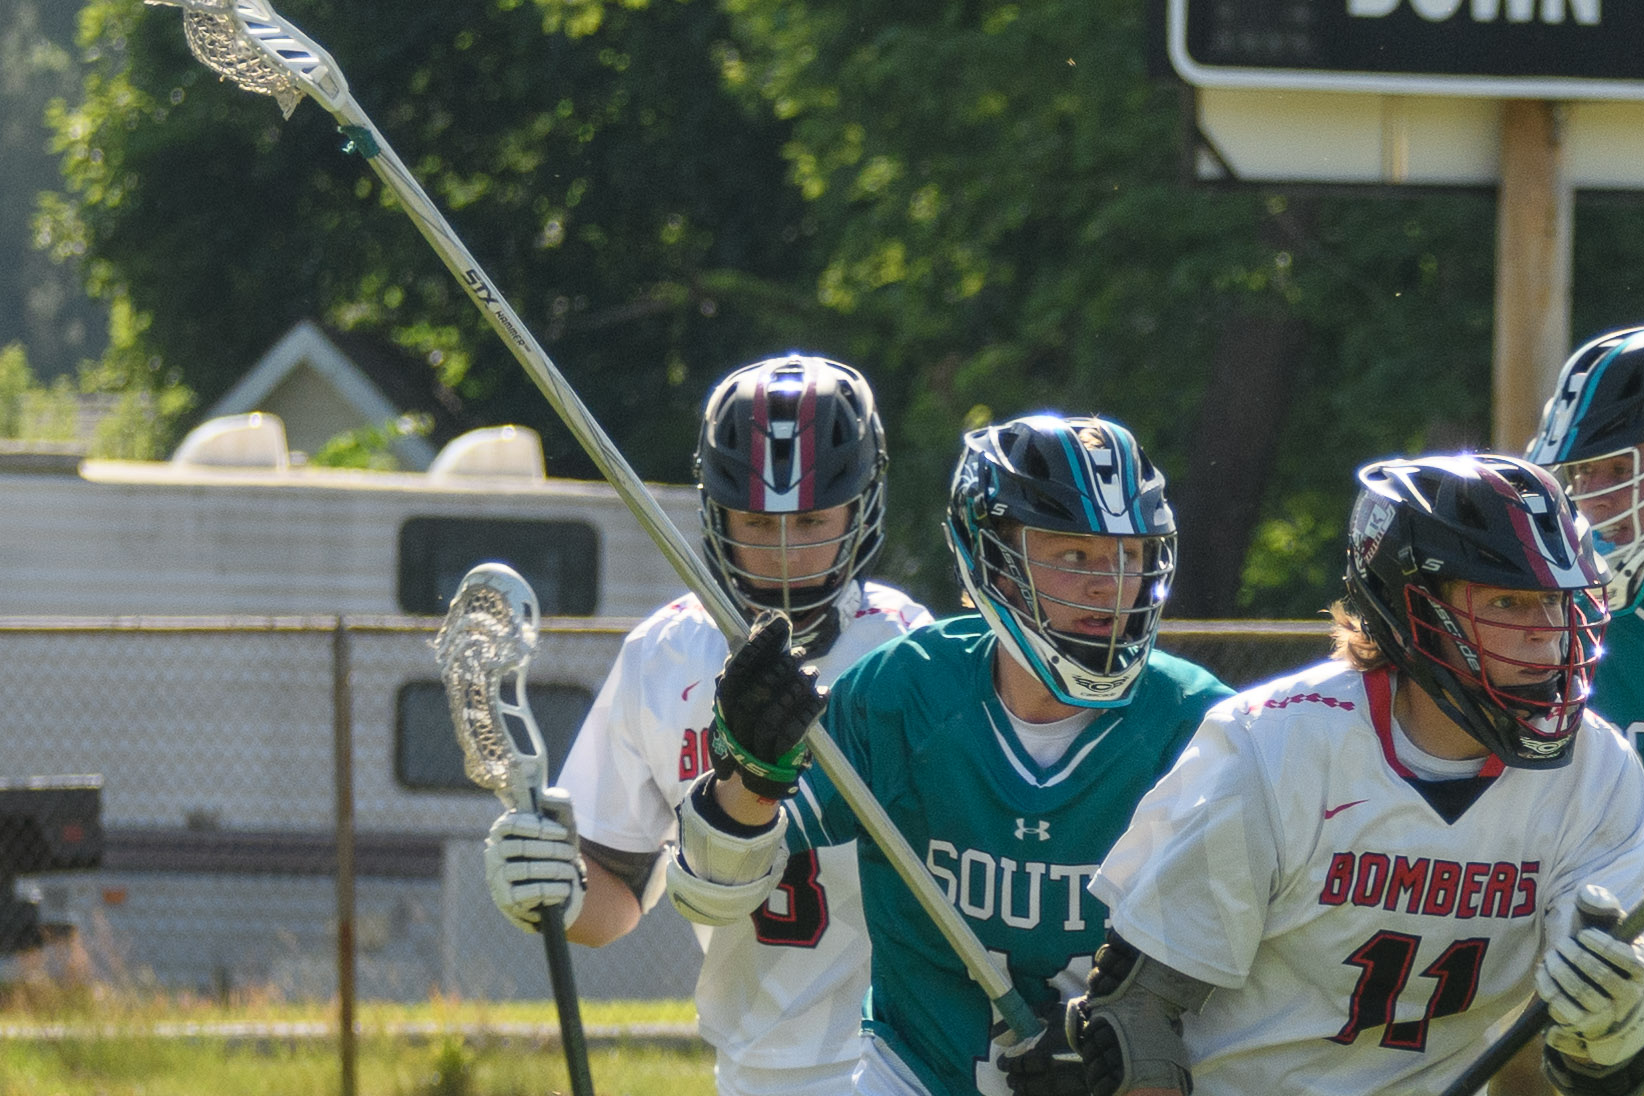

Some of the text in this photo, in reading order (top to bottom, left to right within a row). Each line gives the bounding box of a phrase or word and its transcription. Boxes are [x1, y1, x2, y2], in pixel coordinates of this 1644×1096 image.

[462, 268, 499, 309] STX
[926, 839, 1111, 932] SOUT
[1318, 851, 1541, 920] BOMBERS
[1321, 929, 1491, 1053] 11
